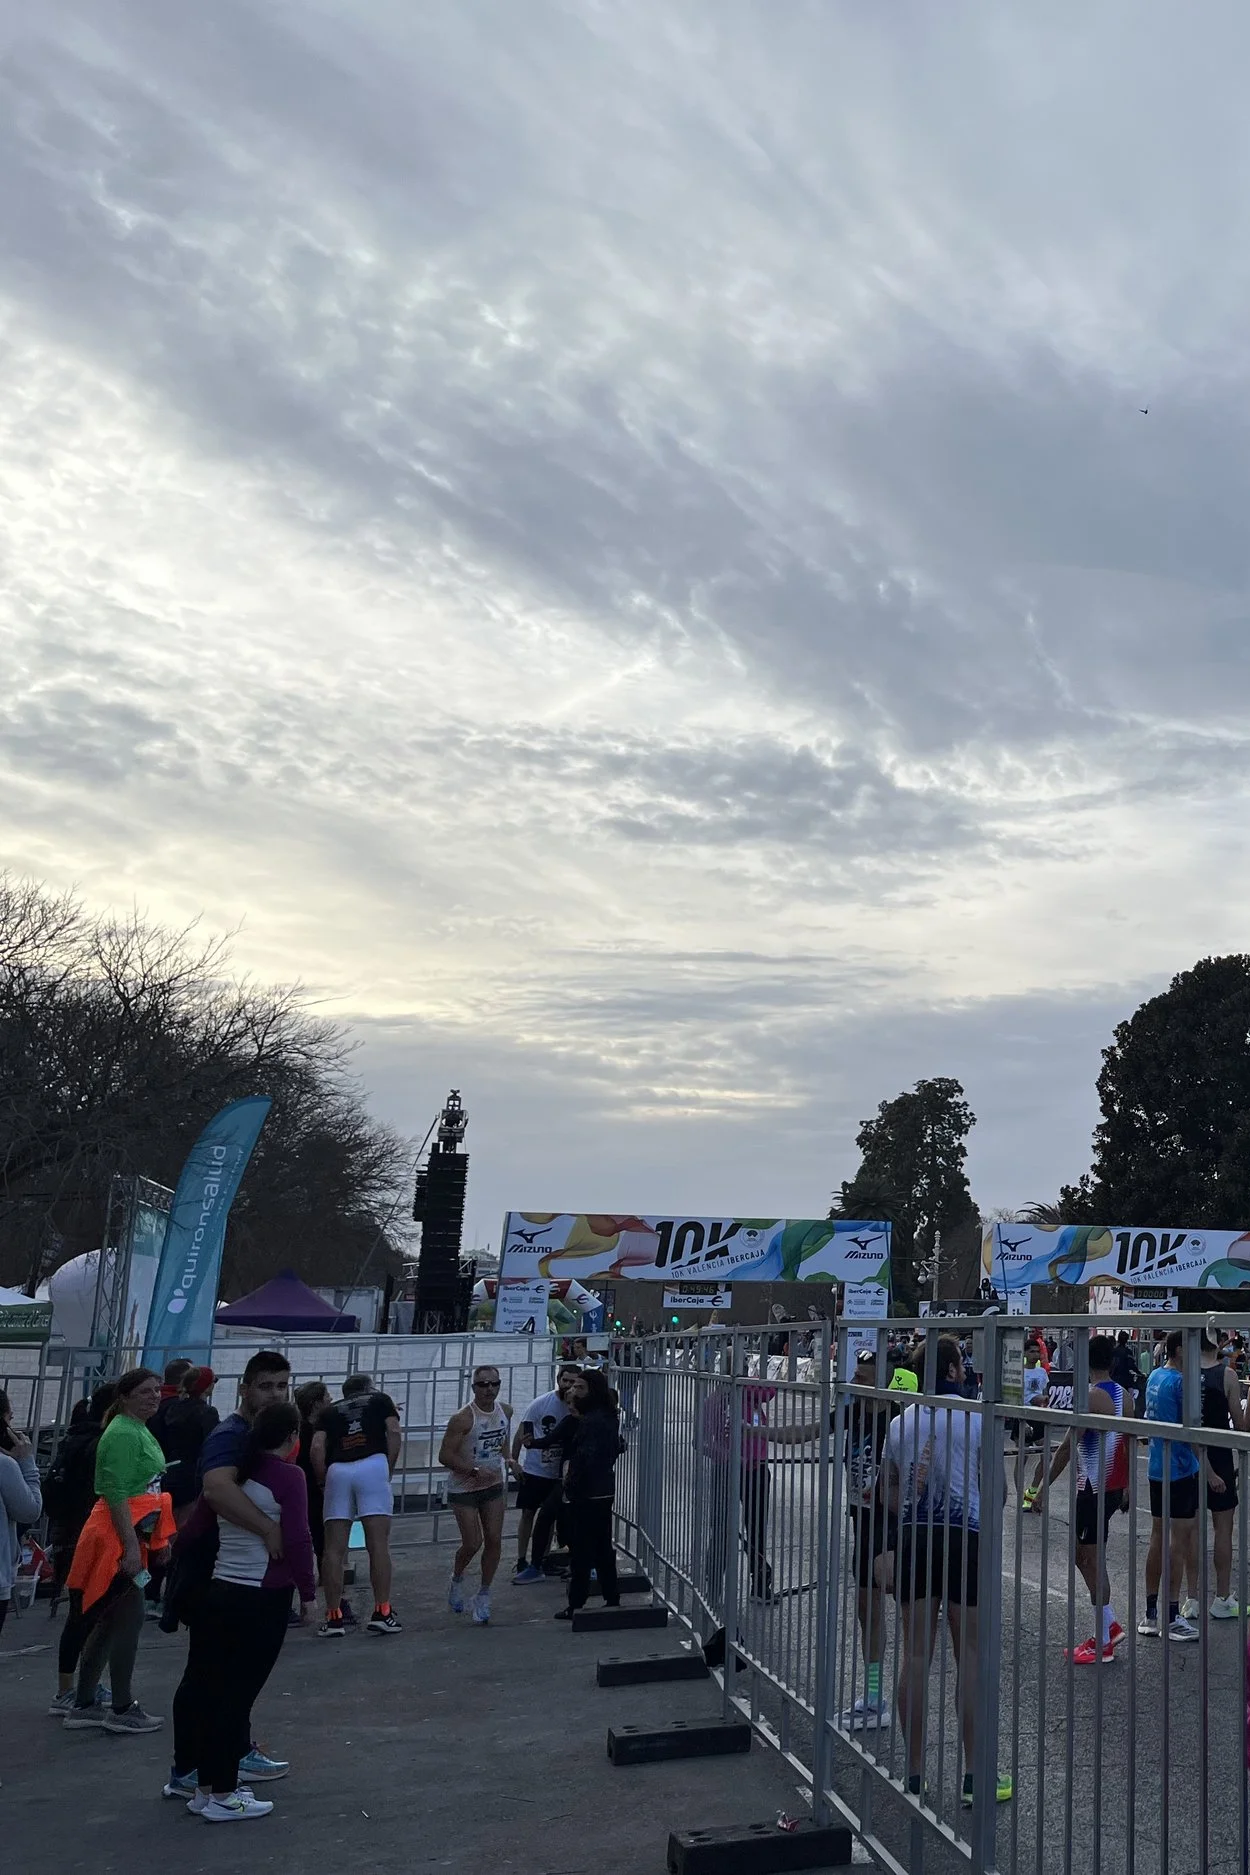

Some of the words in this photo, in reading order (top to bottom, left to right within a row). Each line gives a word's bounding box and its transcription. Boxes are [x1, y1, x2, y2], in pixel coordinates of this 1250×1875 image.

[655, 1221, 743, 1269] 10K
[1115, 1232, 1188, 1275] 10K
[687, 1262, 725, 1275] VALENCIA
[727, 1249, 765, 1264] IBERCAJA
[1175, 1258, 1207, 1272] IBERCAJA
[670, 1296, 704, 1305] iberCaja
[1127, 1301, 1157, 1309] iberCaja
